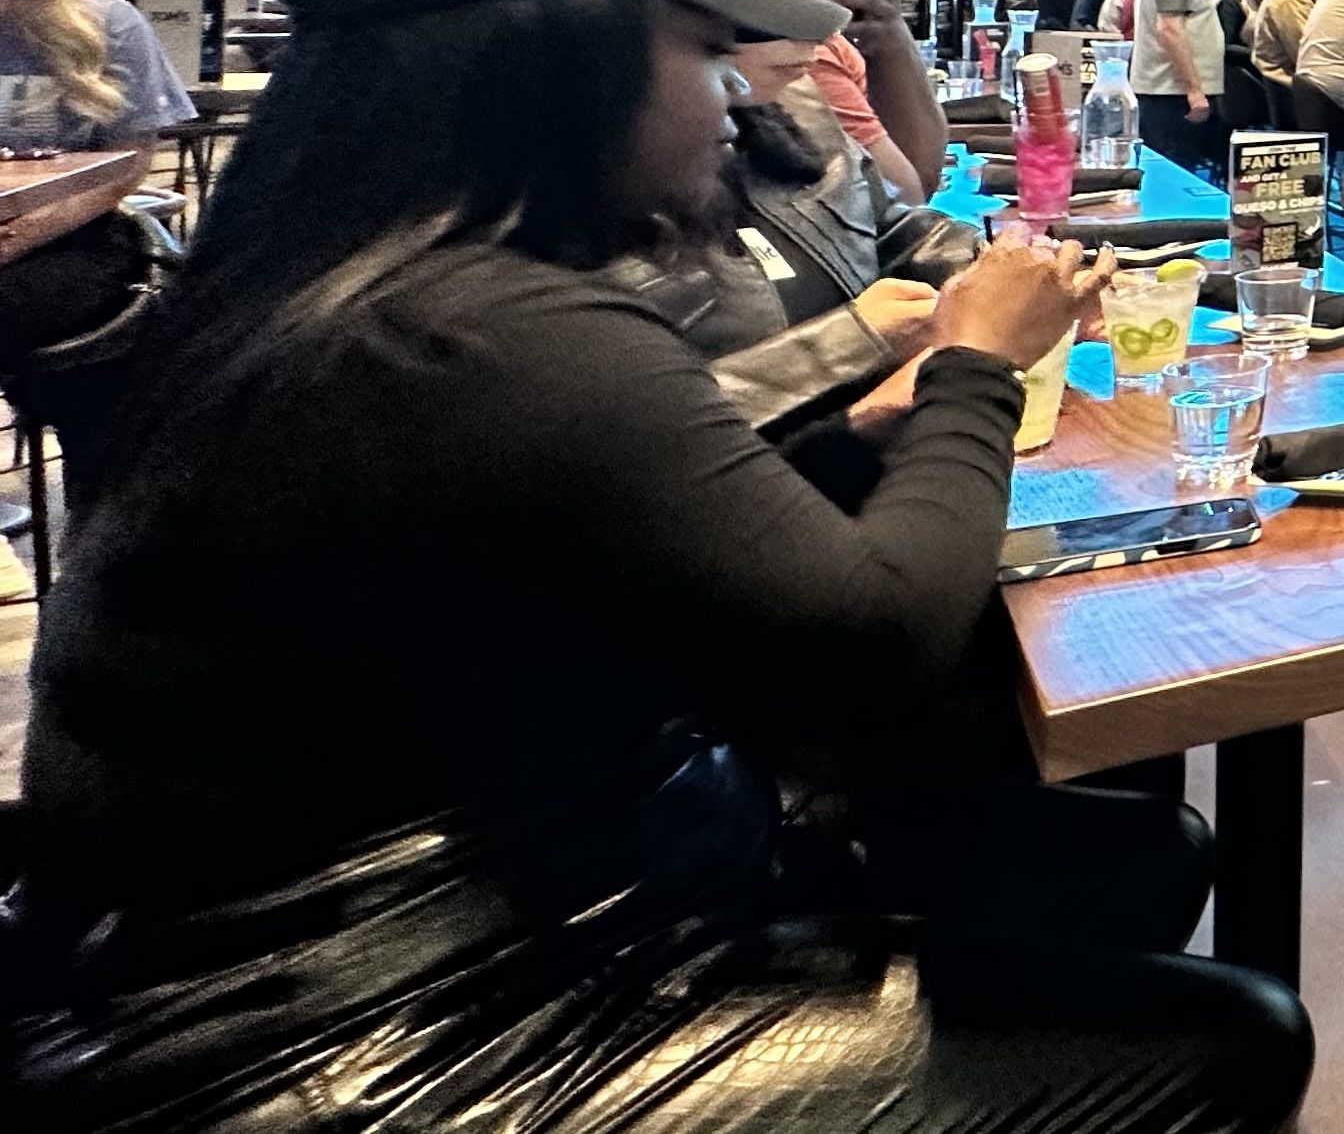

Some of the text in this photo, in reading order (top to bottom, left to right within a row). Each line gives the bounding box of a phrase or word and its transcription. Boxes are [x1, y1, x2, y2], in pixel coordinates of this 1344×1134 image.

[1241, 152, 1321, 170] FAN CLUB
[1240, 174, 1260, 183] AND
[1261, 172, 1280, 182] GET
[1255, 179, 1305, 197] FREE
[1233, 200, 1277, 214] QUESO
[1278, 199, 1287, 210] &
